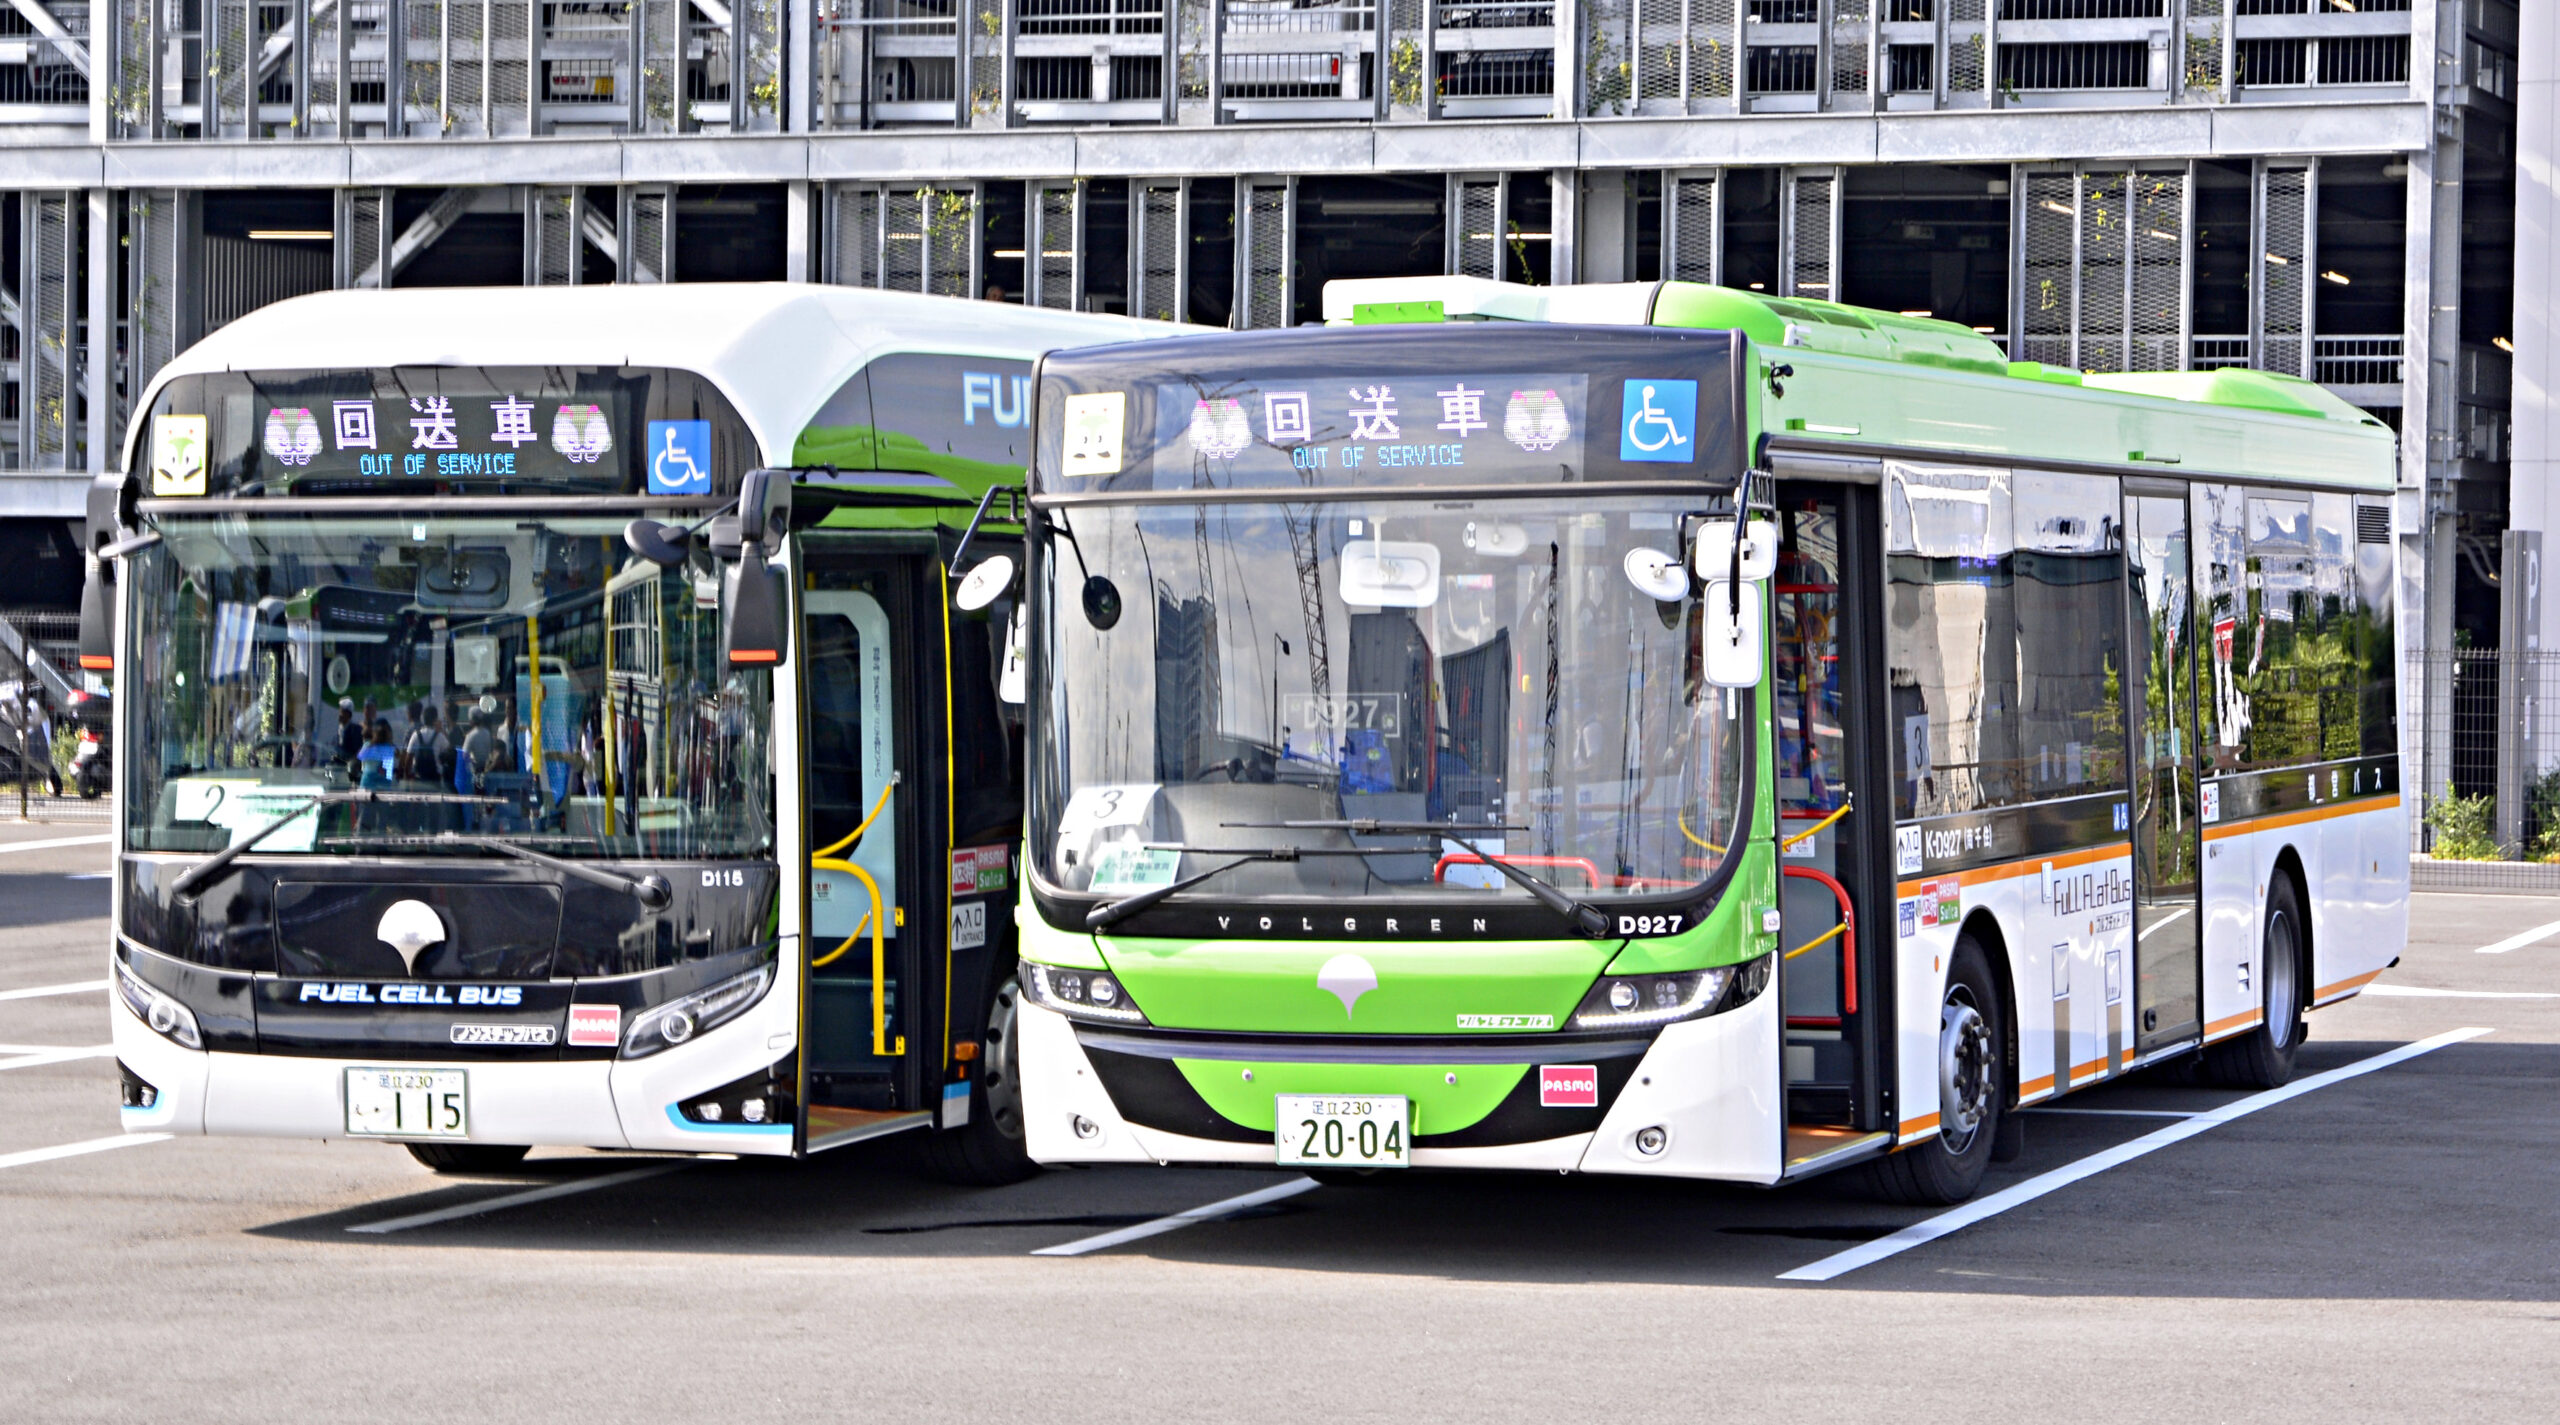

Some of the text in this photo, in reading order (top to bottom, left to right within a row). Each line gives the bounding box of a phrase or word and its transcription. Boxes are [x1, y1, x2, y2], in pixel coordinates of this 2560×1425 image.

[332, 394, 537, 450] 回送車
[1264, 382, 1488, 442] 回送車
[360, 452, 517, 475] OUT OF SERVICE
[1293, 443, 1465, 469] OUT OF SERVICE
[1303, 699, 1379, 729] D927
[1914, 725, 1923, 770] 3
[204, 784, 225, 821] 2
[1094, 789, 1124, 819] 3
[978, 850, 1005, 866] PASMO
[701, 869, 744, 887] D115
[979, 870, 1004, 888] Suica
[964, 908, 982, 928] 入口
[1218, 916, 1488, 933] VOLGREN
[1618, 915, 1683, 936] D927
[300, 982, 523, 1006] FUEL CELL BUS
[1543, 1079, 1594, 1092] PASMO
[1341, 1101, 1372, 1116] 230
[1300, 1119, 1403, 1159] 20-04
